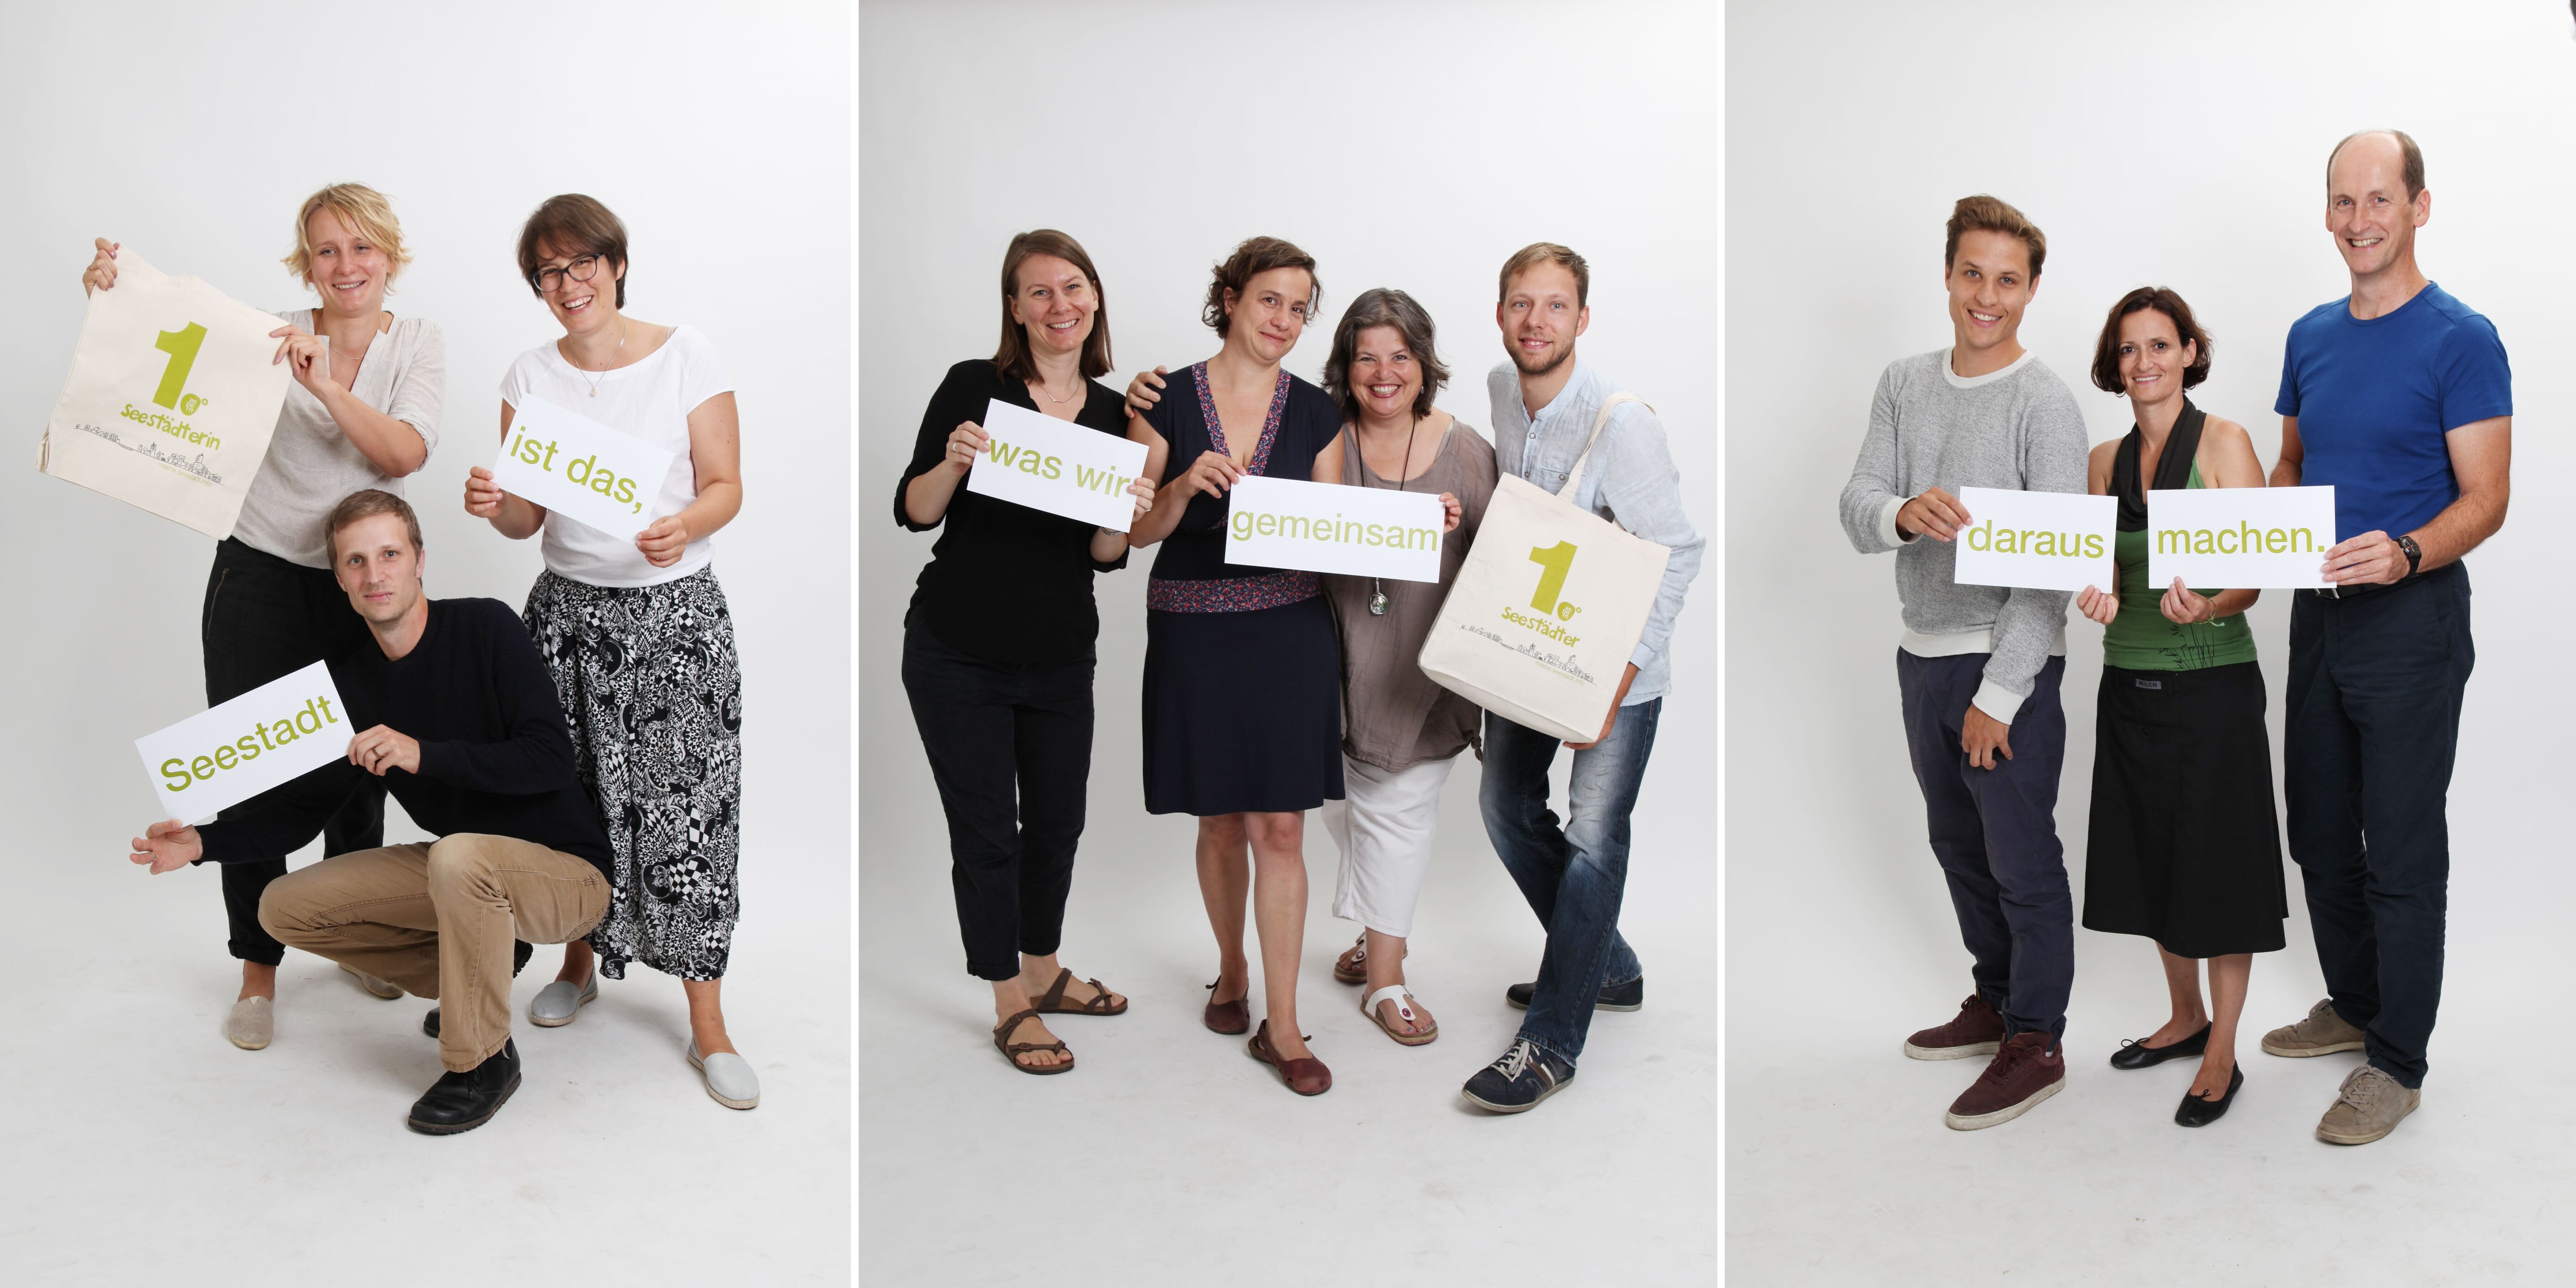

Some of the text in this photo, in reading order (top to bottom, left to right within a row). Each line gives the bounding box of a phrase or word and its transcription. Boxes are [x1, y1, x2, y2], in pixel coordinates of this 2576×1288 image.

[158, 462, 212, 487] meine.seestadt.info
[510, 426, 642, 514] ist das,
[990, 439, 1131, 498] was wir
[1232, 511, 1437, 551] gemeinsam
[1968, 520, 2104, 559] daraus
[2158, 520, 2325, 554] machen.
[1535, 661, 1585, 686] meine.seestadt.info
[160, 695, 338, 792] Seestadt
